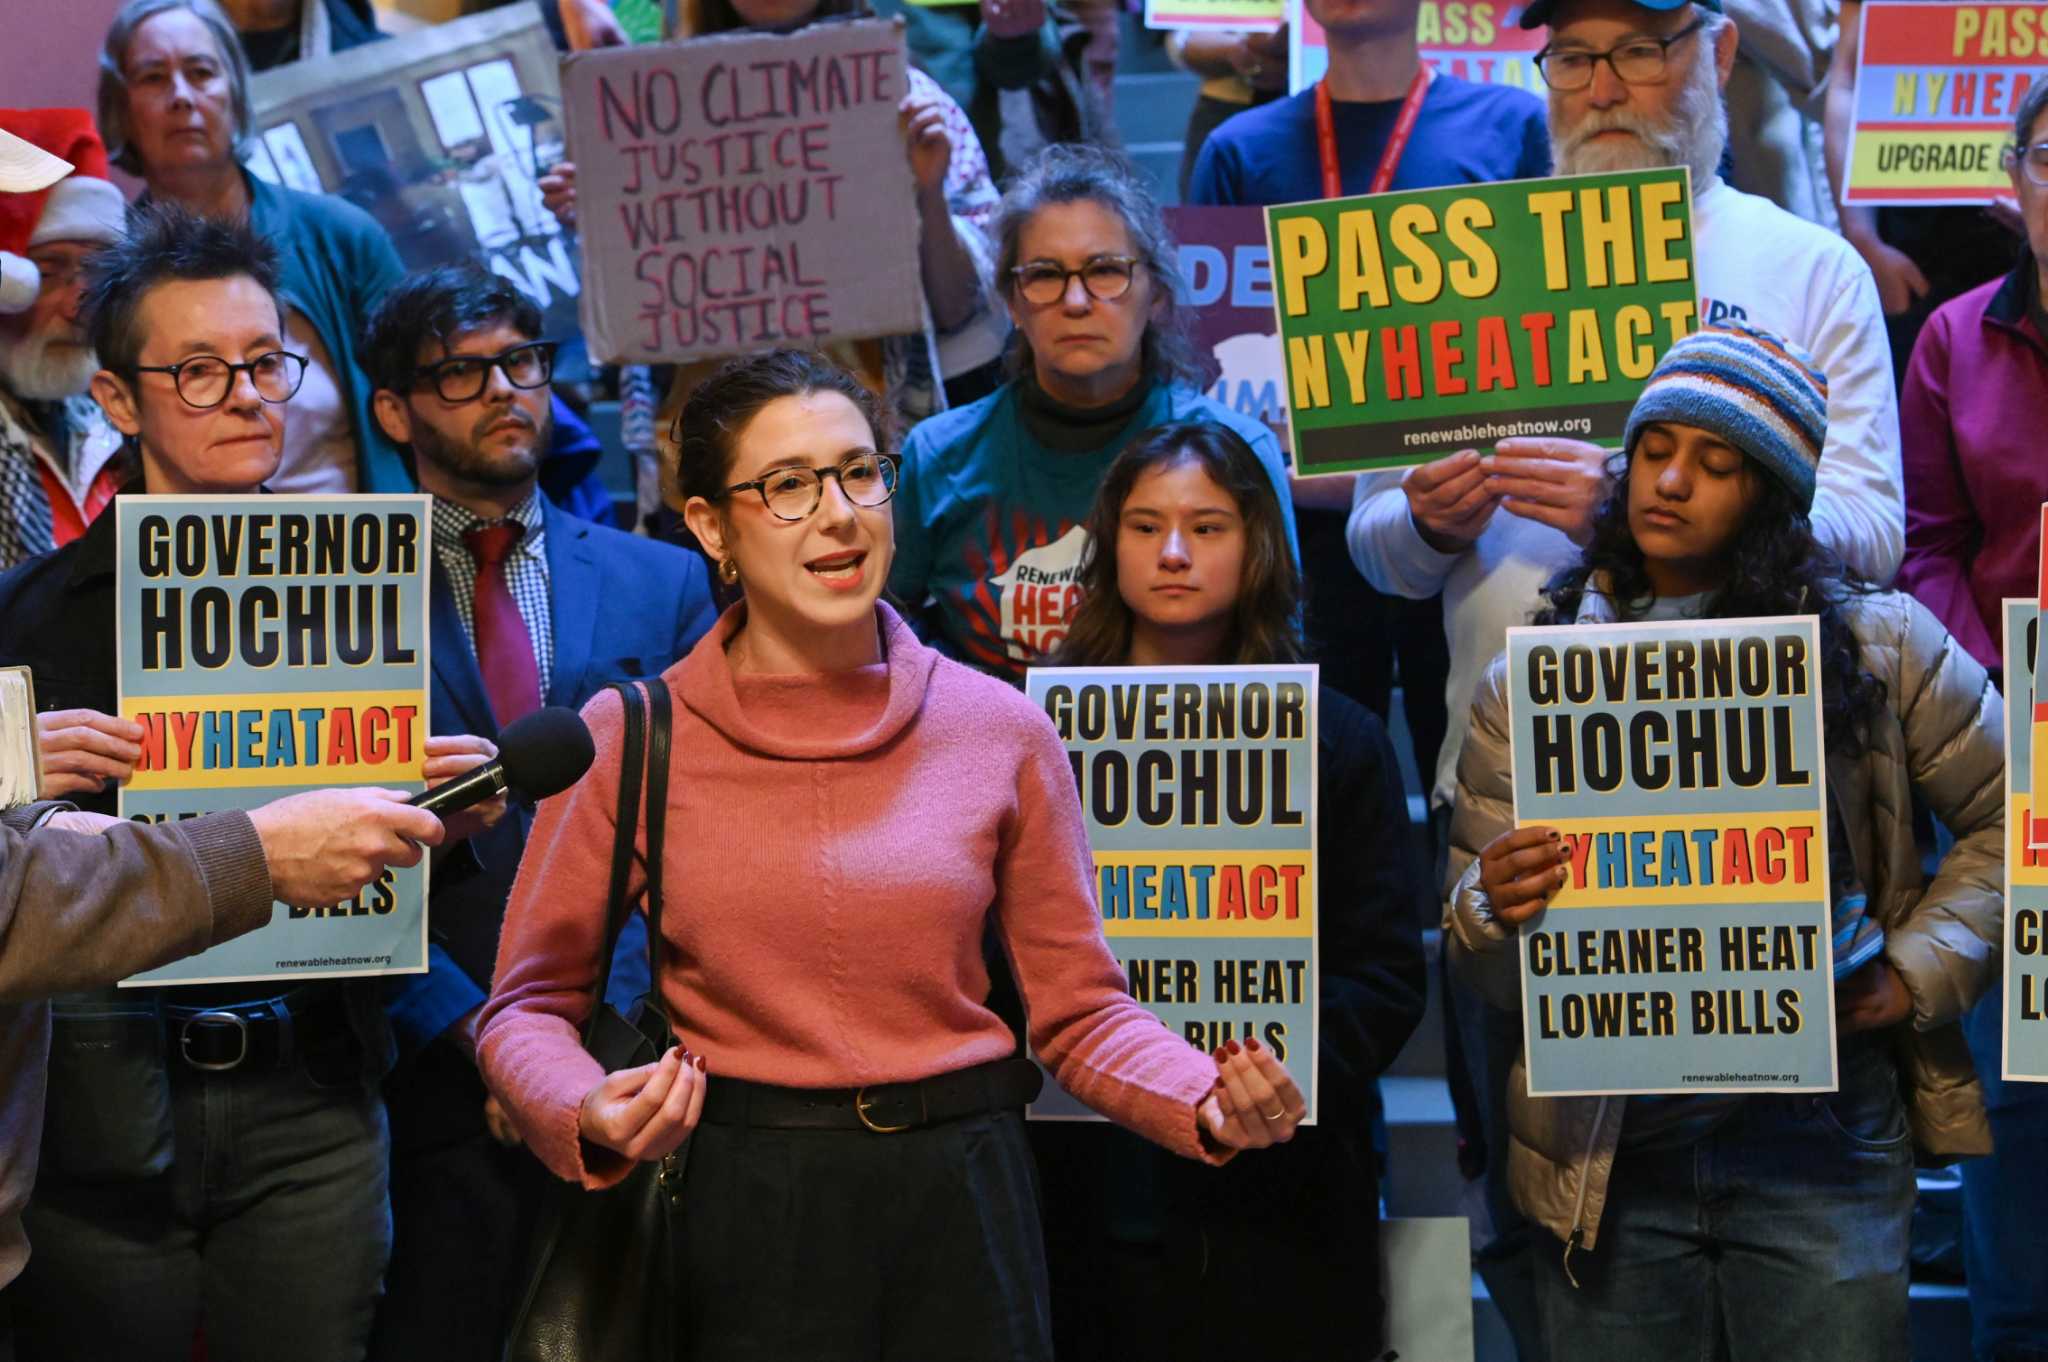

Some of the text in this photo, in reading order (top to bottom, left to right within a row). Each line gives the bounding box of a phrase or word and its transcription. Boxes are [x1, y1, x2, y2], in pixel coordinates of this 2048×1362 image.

[1416, 2, 1495, 45] ASS
[598, 49, 897, 140] NO CLIMATE
[620, 123, 831, 195] JUSTICE
[1877, 143, 1992, 173] UPGRADE
[619, 175, 844, 250] WITHOUT
[636, 241, 826, 309] SOCIAL
[1277, 181, 1691, 316] PASS THE
[639, 293, 831, 351] JUSTICE
[1403, 416, 1592, 446] renewableheatnow.org
[139, 513, 419, 578] GOVERNOR
[141, 584, 418, 671] HOCHUL
[1013, 583, 1085, 626] HEA
[1528, 635, 1809, 706] GOVERNOR
[1045, 682, 1306, 743] GOVERNOR
[1533, 706, 1811, 796] HOCHUL
[275, 955, 392, 969] renewableheatnow.org
[1529, 925, 1821, 977] CLEANER HEAT
[1214, 959, 1309, 1004] HEAT
[1539, 989, 1804, 1039] LOWER BILLS
[1682, 1072, 1800, 1083] renewableheatnow.org
